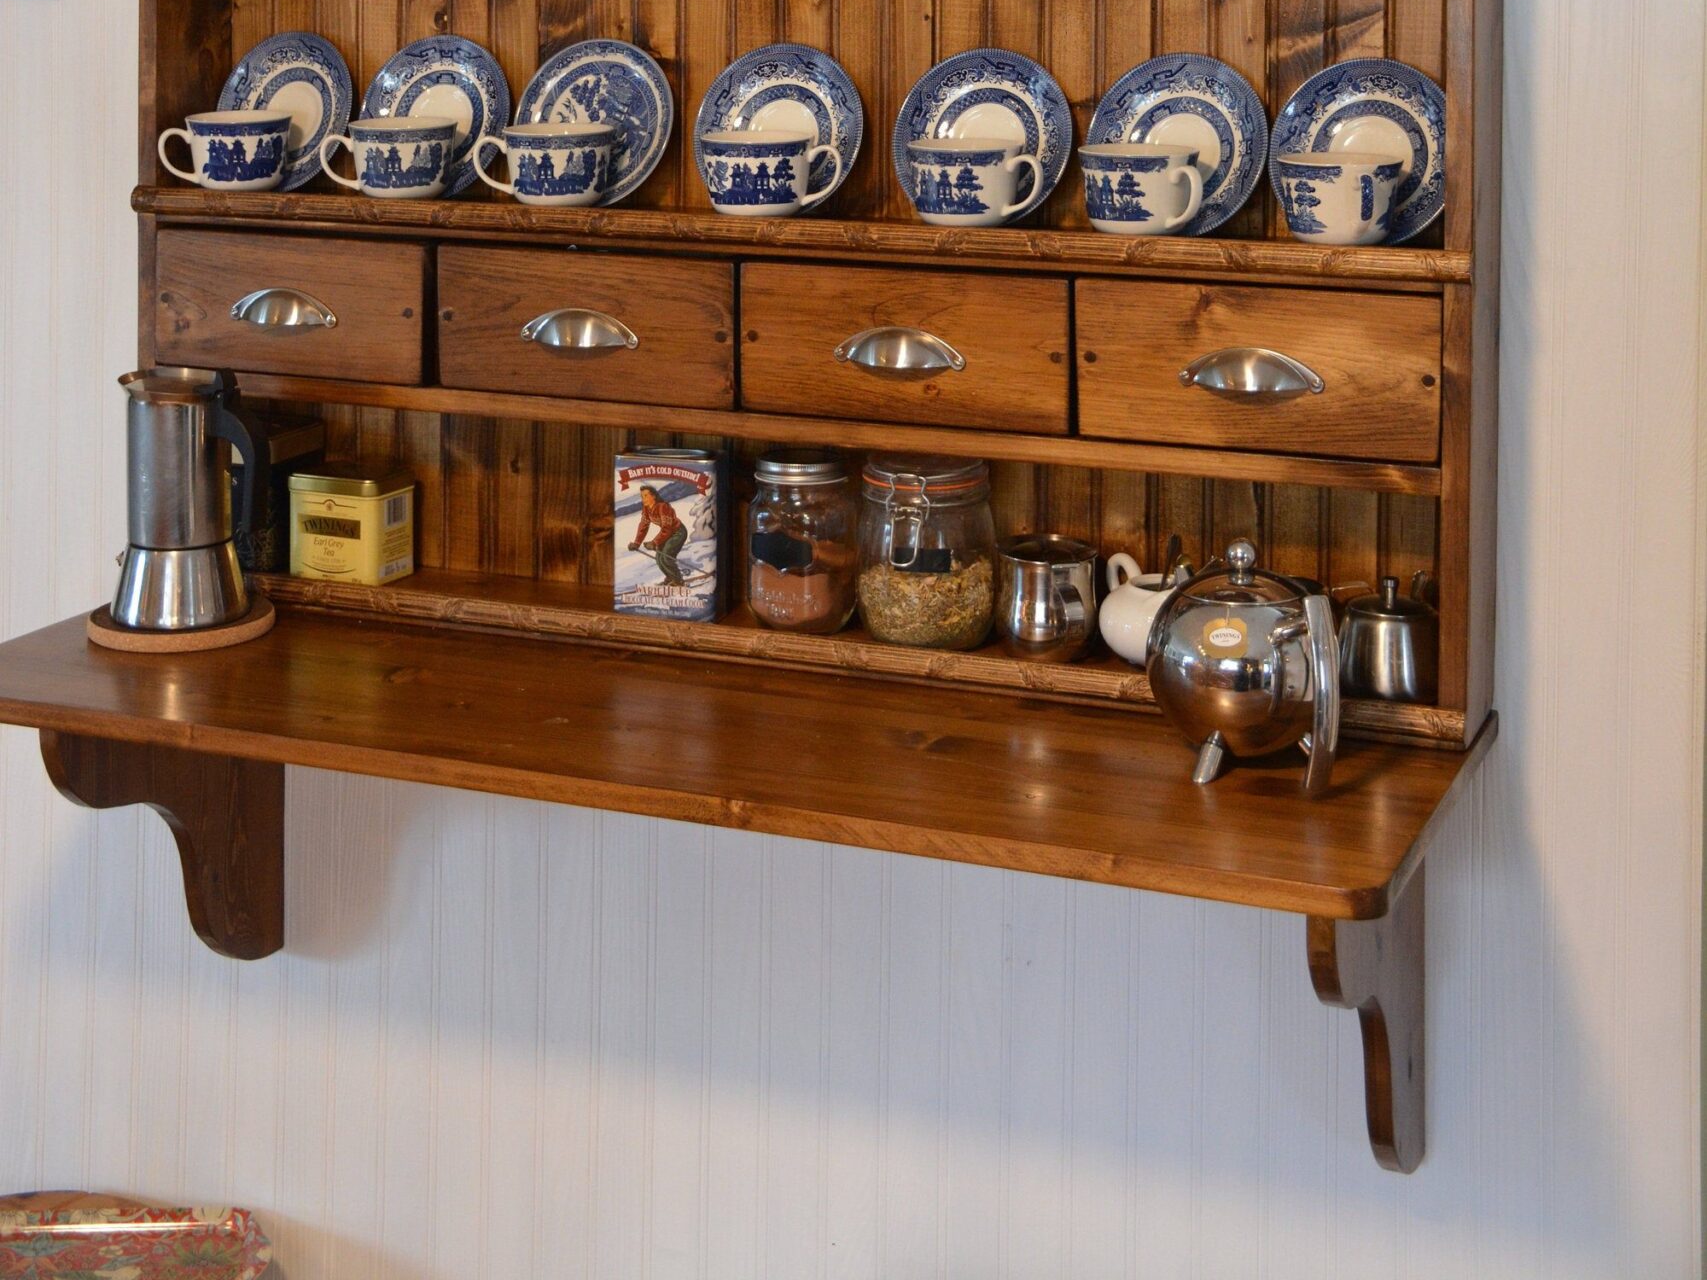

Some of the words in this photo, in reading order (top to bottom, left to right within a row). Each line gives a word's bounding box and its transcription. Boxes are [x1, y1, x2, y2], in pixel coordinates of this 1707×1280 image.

[628, 468, 644, 478] BABY
[645, 465, 656, 475] IT'S
[657, 466, 672, 475] COLD
[673, 468, 701, 482] OUTSIDE!
[302, 518, 356, 537] TWININGS
[314, 536, 328, 546] Earl
[328, 538, 345, 549] Grey
[323, 547, 335, 557] Tea
